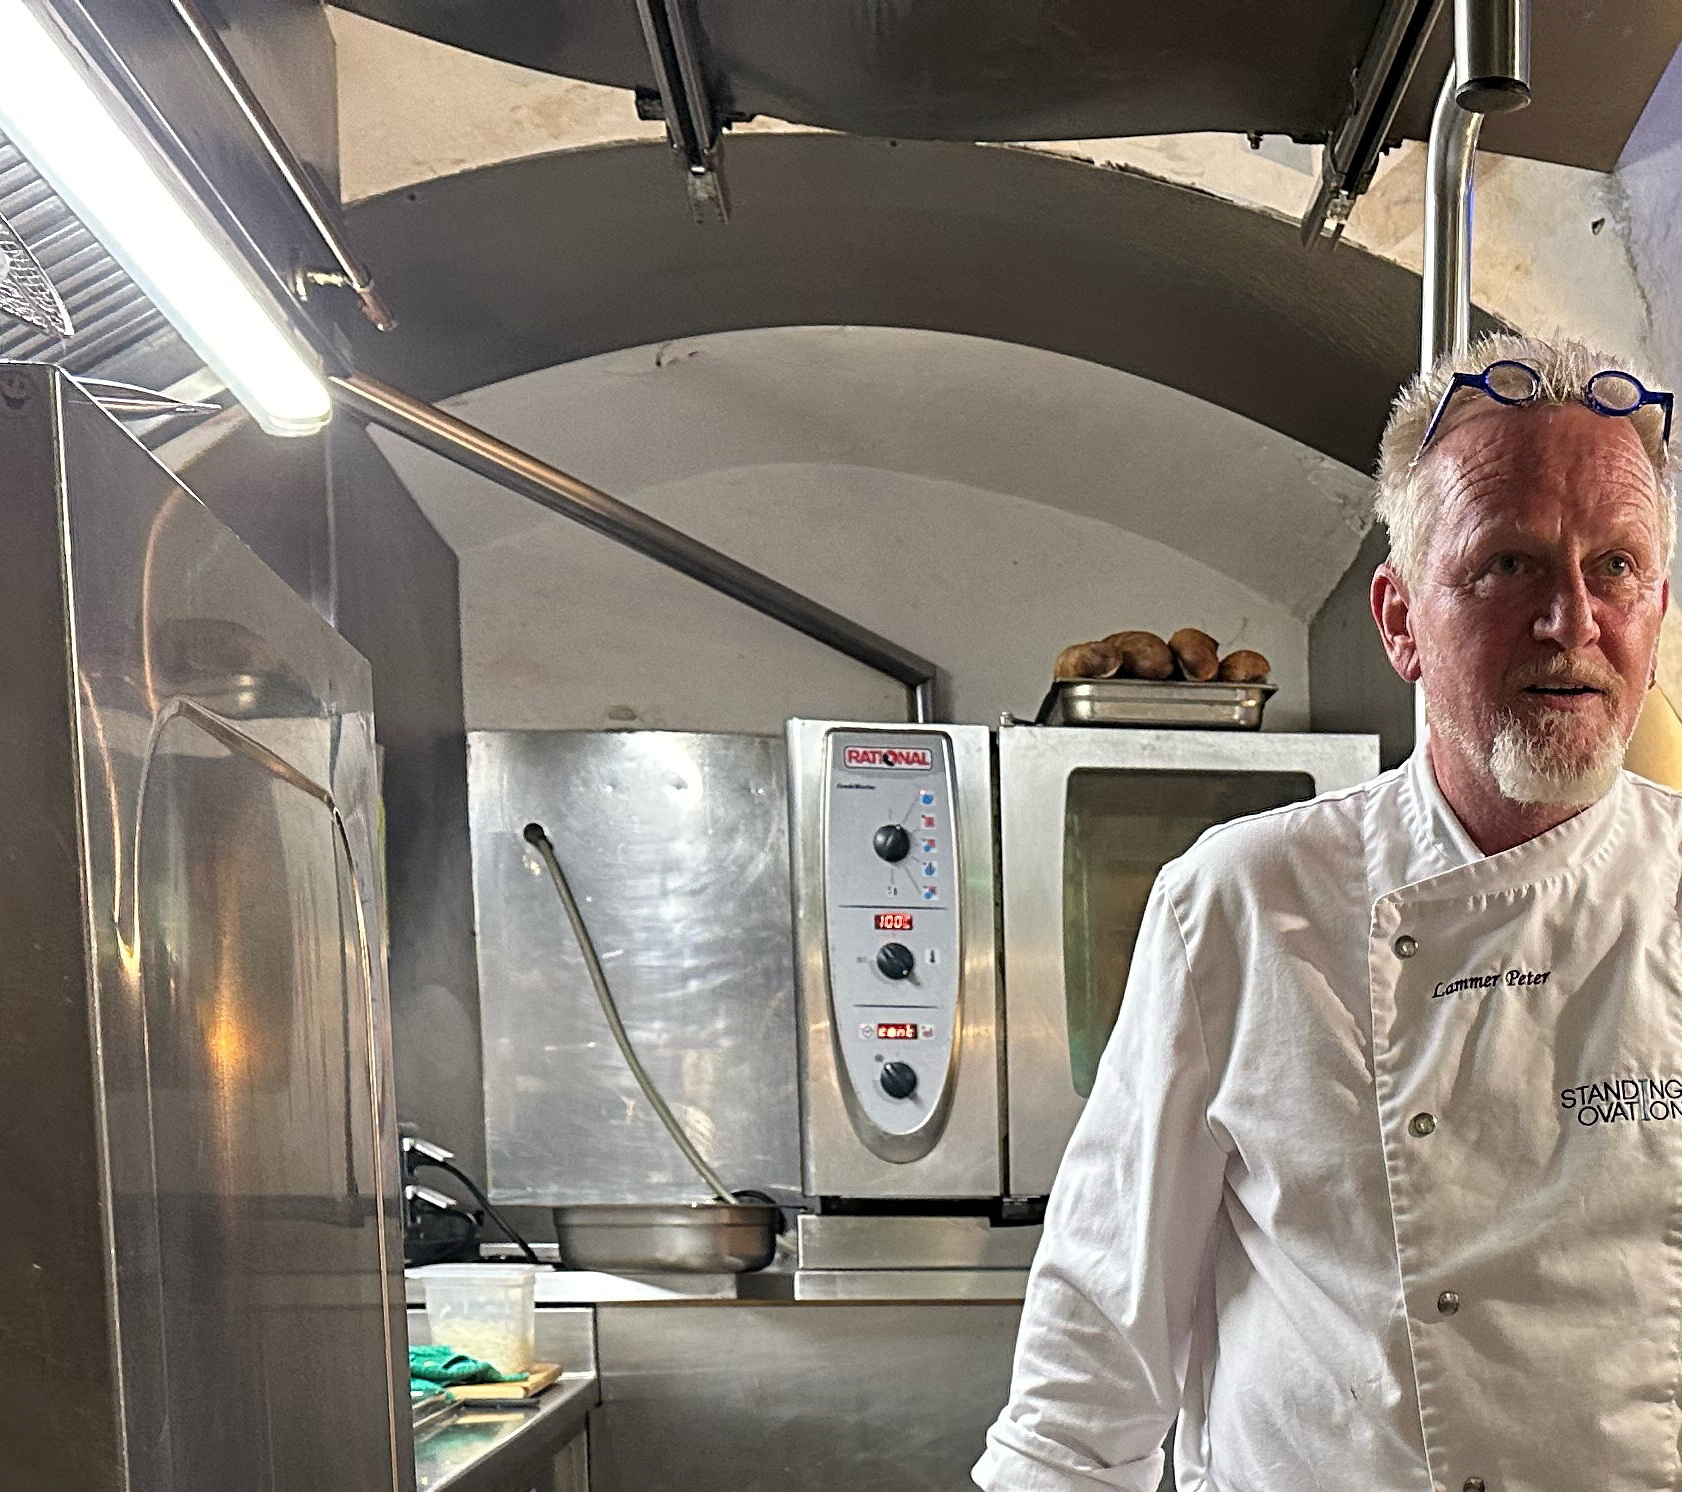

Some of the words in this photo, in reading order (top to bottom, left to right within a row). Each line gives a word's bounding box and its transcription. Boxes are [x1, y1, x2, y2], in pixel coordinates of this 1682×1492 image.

[847, 749, 930, 766] RATIONAL
[1432, 973, 1501, 999] Lammer
[1505, 969, 1551, 987] Peter
